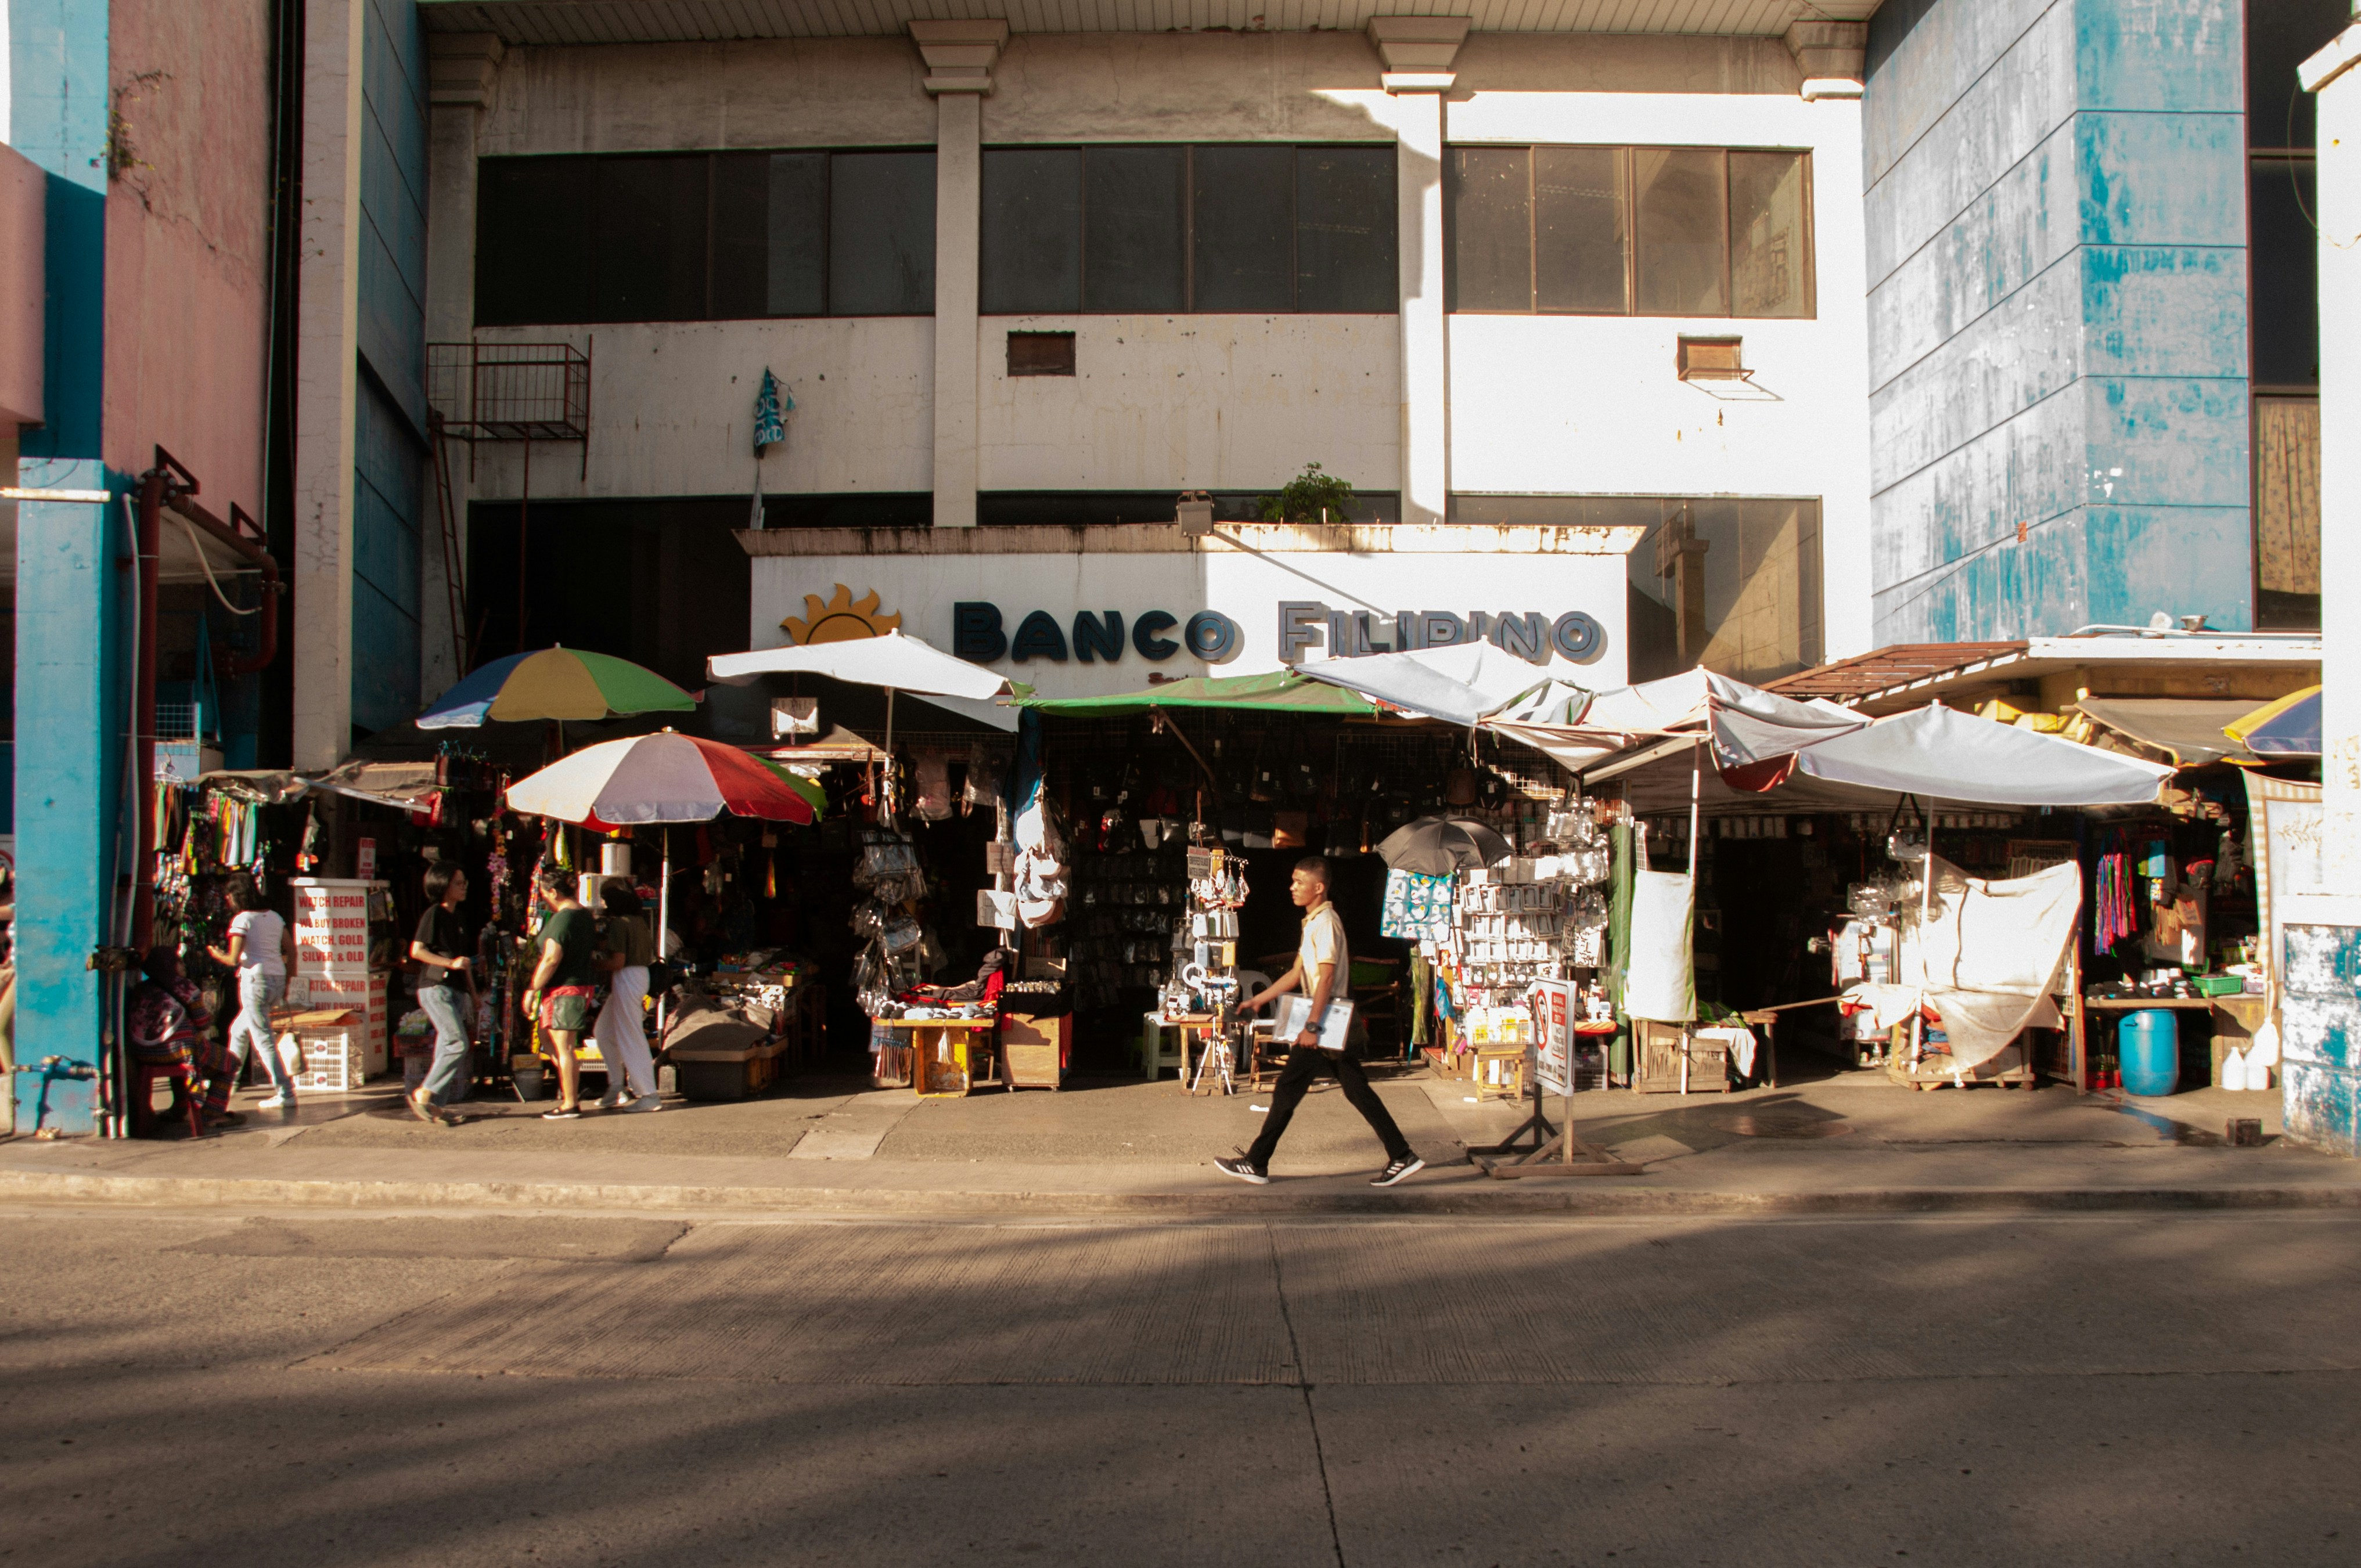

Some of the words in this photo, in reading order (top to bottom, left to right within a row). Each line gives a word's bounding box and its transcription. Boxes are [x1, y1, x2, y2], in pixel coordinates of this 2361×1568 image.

[953, 601, 1236, 664] BANCO
[1277, 600, 1601, 662] FILIPINO
[299, 896, 331, 907] WATCH
[333, 896, 365, 907] REPAIR
[315, 918, 330, 928] BUY
[333, 918, 365, 928] BROKEN
[337, 953, 344, 961] &
[347, 951, 364, 961] OLD
[309, 980, 332, 991] ATCH
[335, 980, 365, 992] REPAIR
